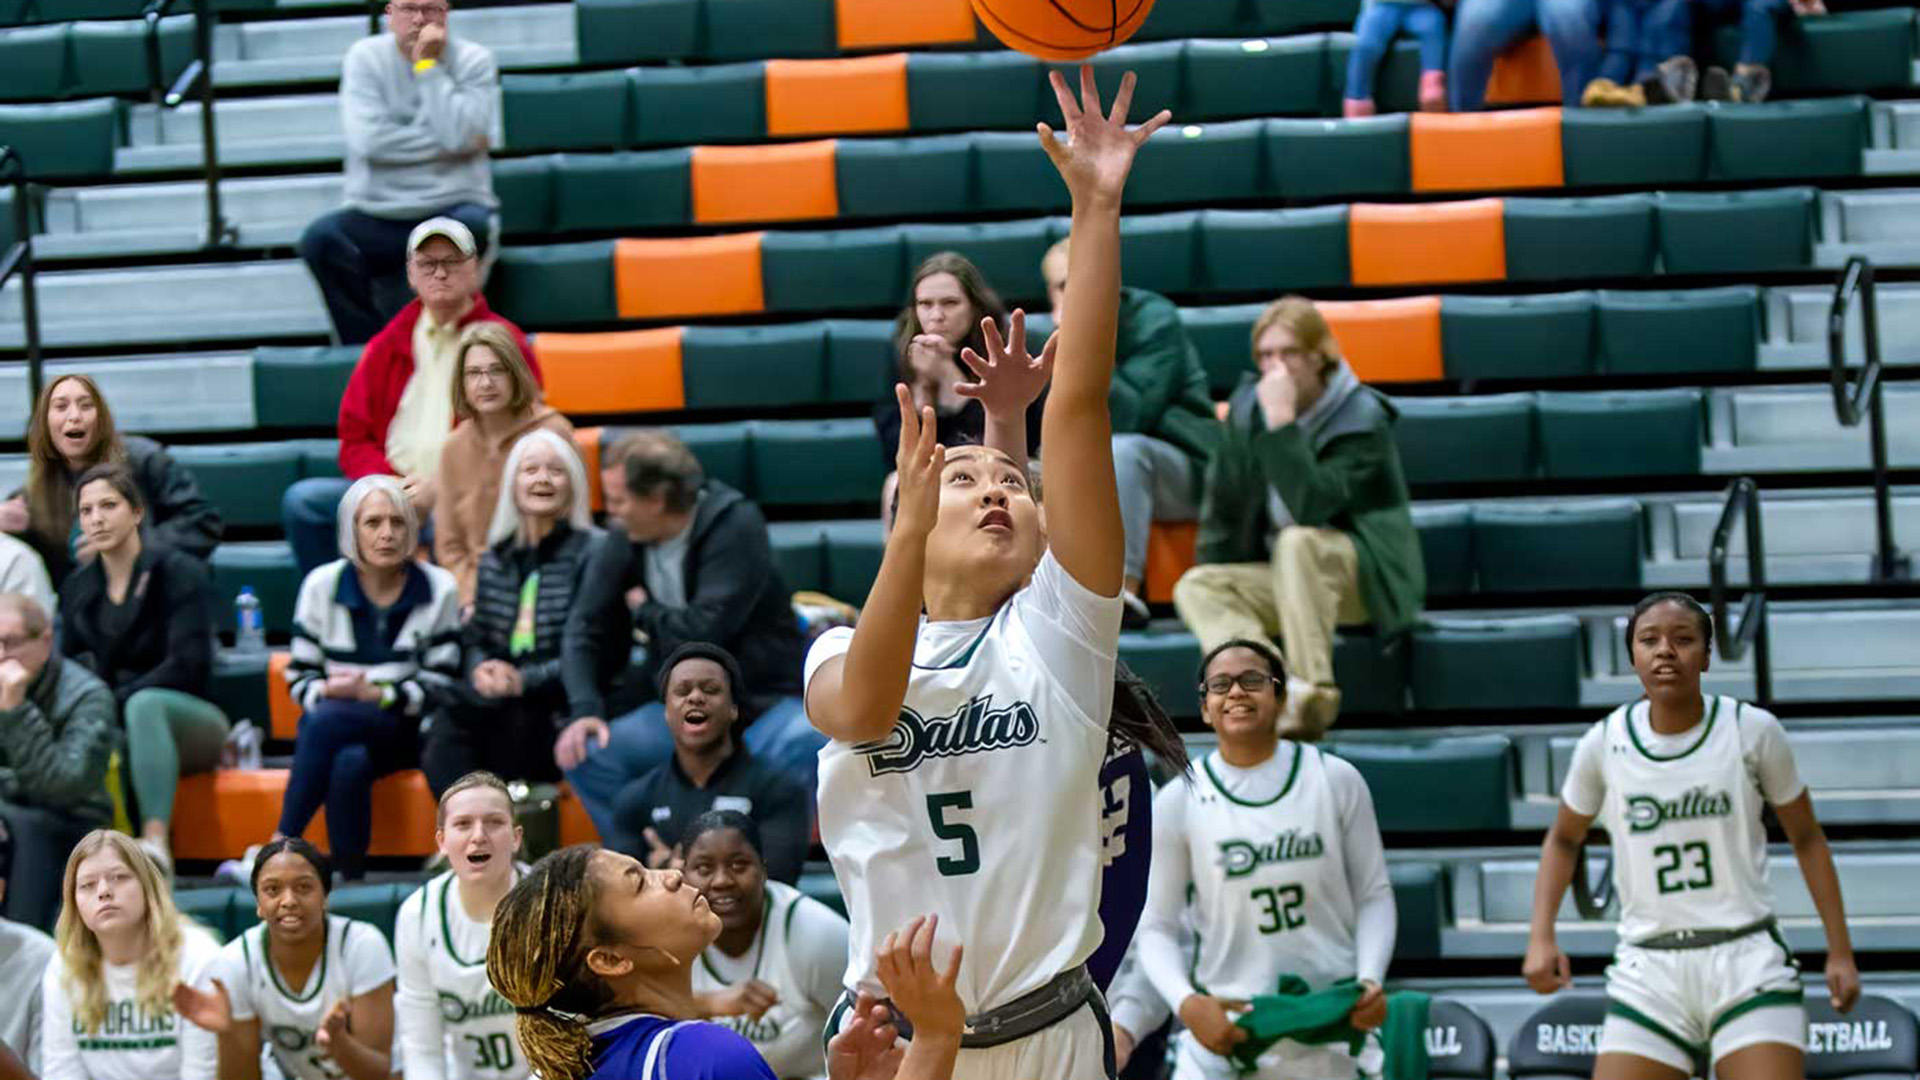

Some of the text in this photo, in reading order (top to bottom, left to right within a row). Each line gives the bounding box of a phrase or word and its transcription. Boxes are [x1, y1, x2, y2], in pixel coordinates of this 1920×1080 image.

[866, 693, 1038, 777] Dallas
[926, 790, 981, 876] 5
[1624, 785, 1731, 834] Dallas
[1217, 828, 1324, 879] Dallas
[1654, 841, 1713, 893] 23
[1252, 884, 1306, 934] 32
[464, 1033, 514, 1070] 30
